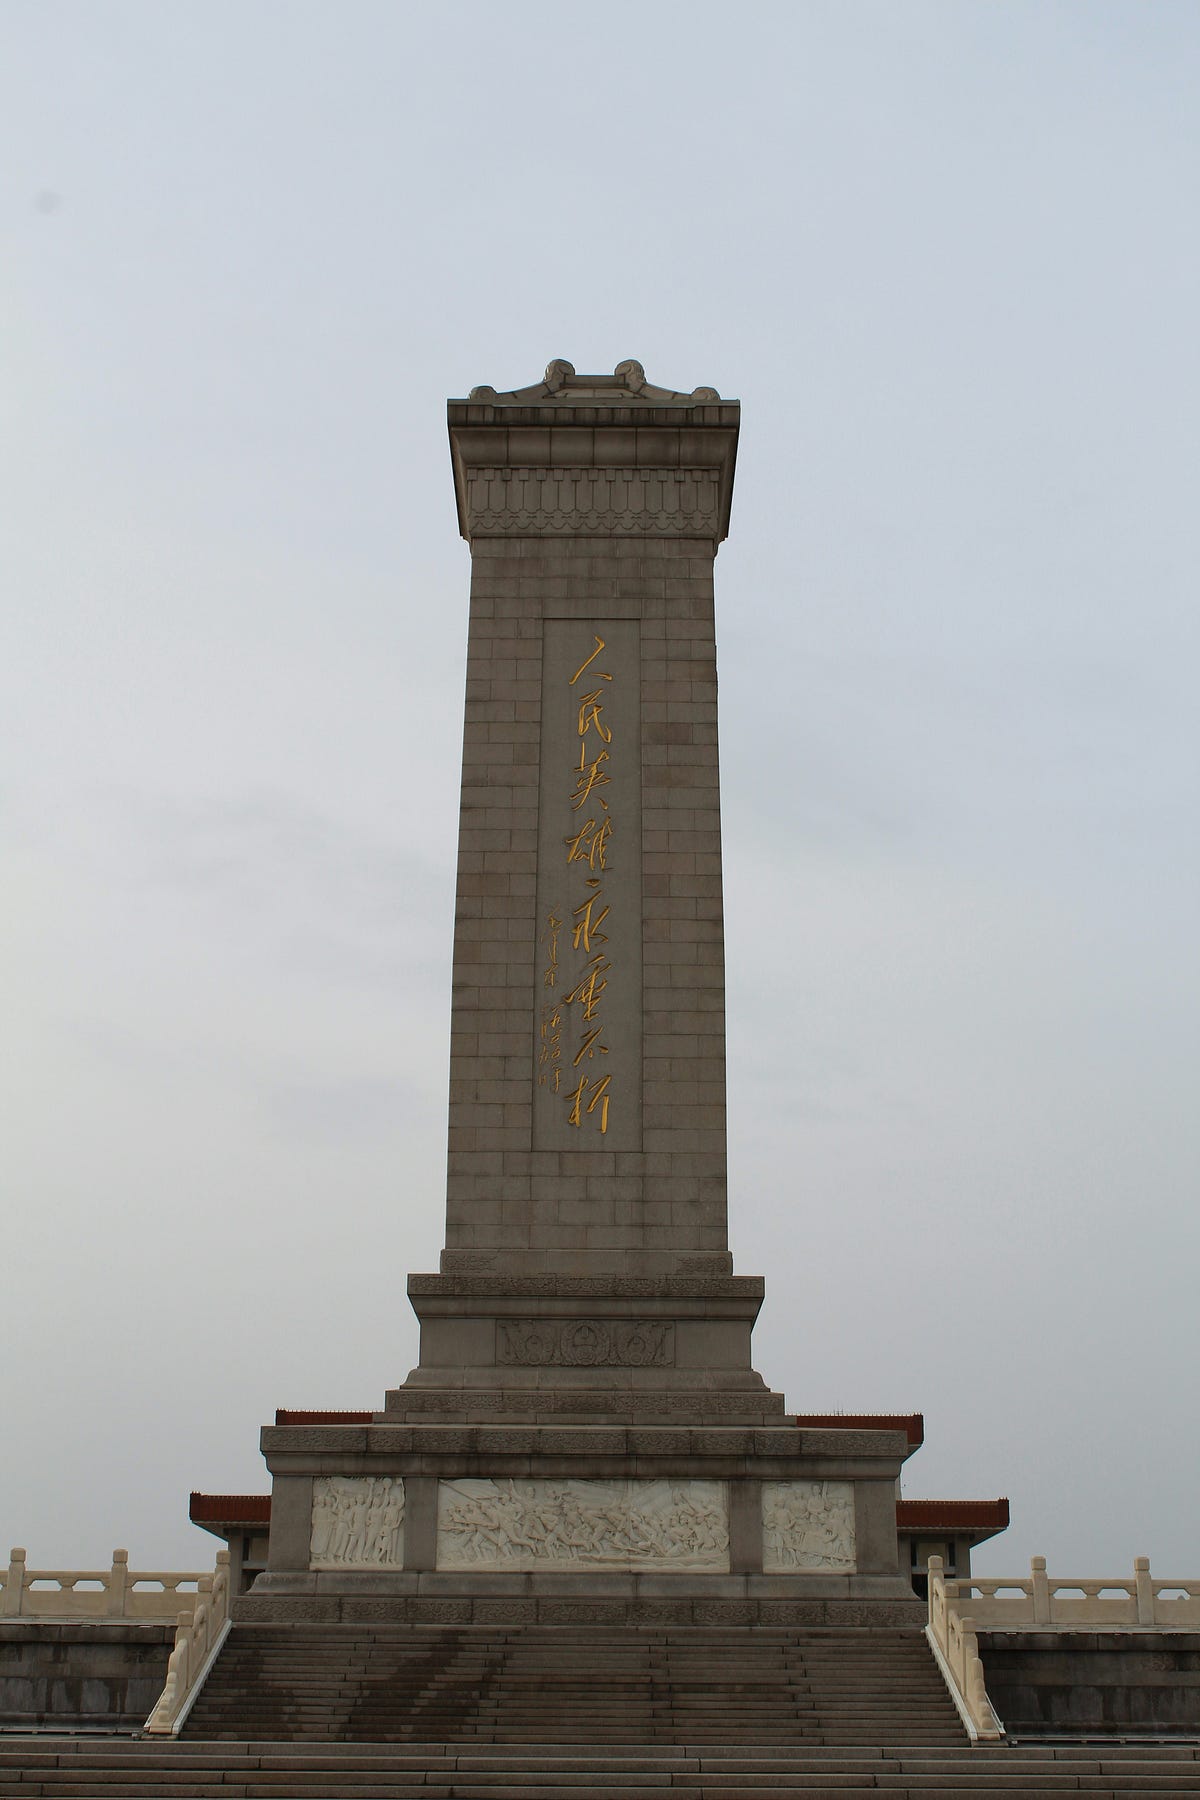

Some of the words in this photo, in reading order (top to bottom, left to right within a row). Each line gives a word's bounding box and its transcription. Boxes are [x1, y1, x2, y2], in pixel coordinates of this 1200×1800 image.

[565, 635, 614, 1134] 人民英雄永垂不朽
